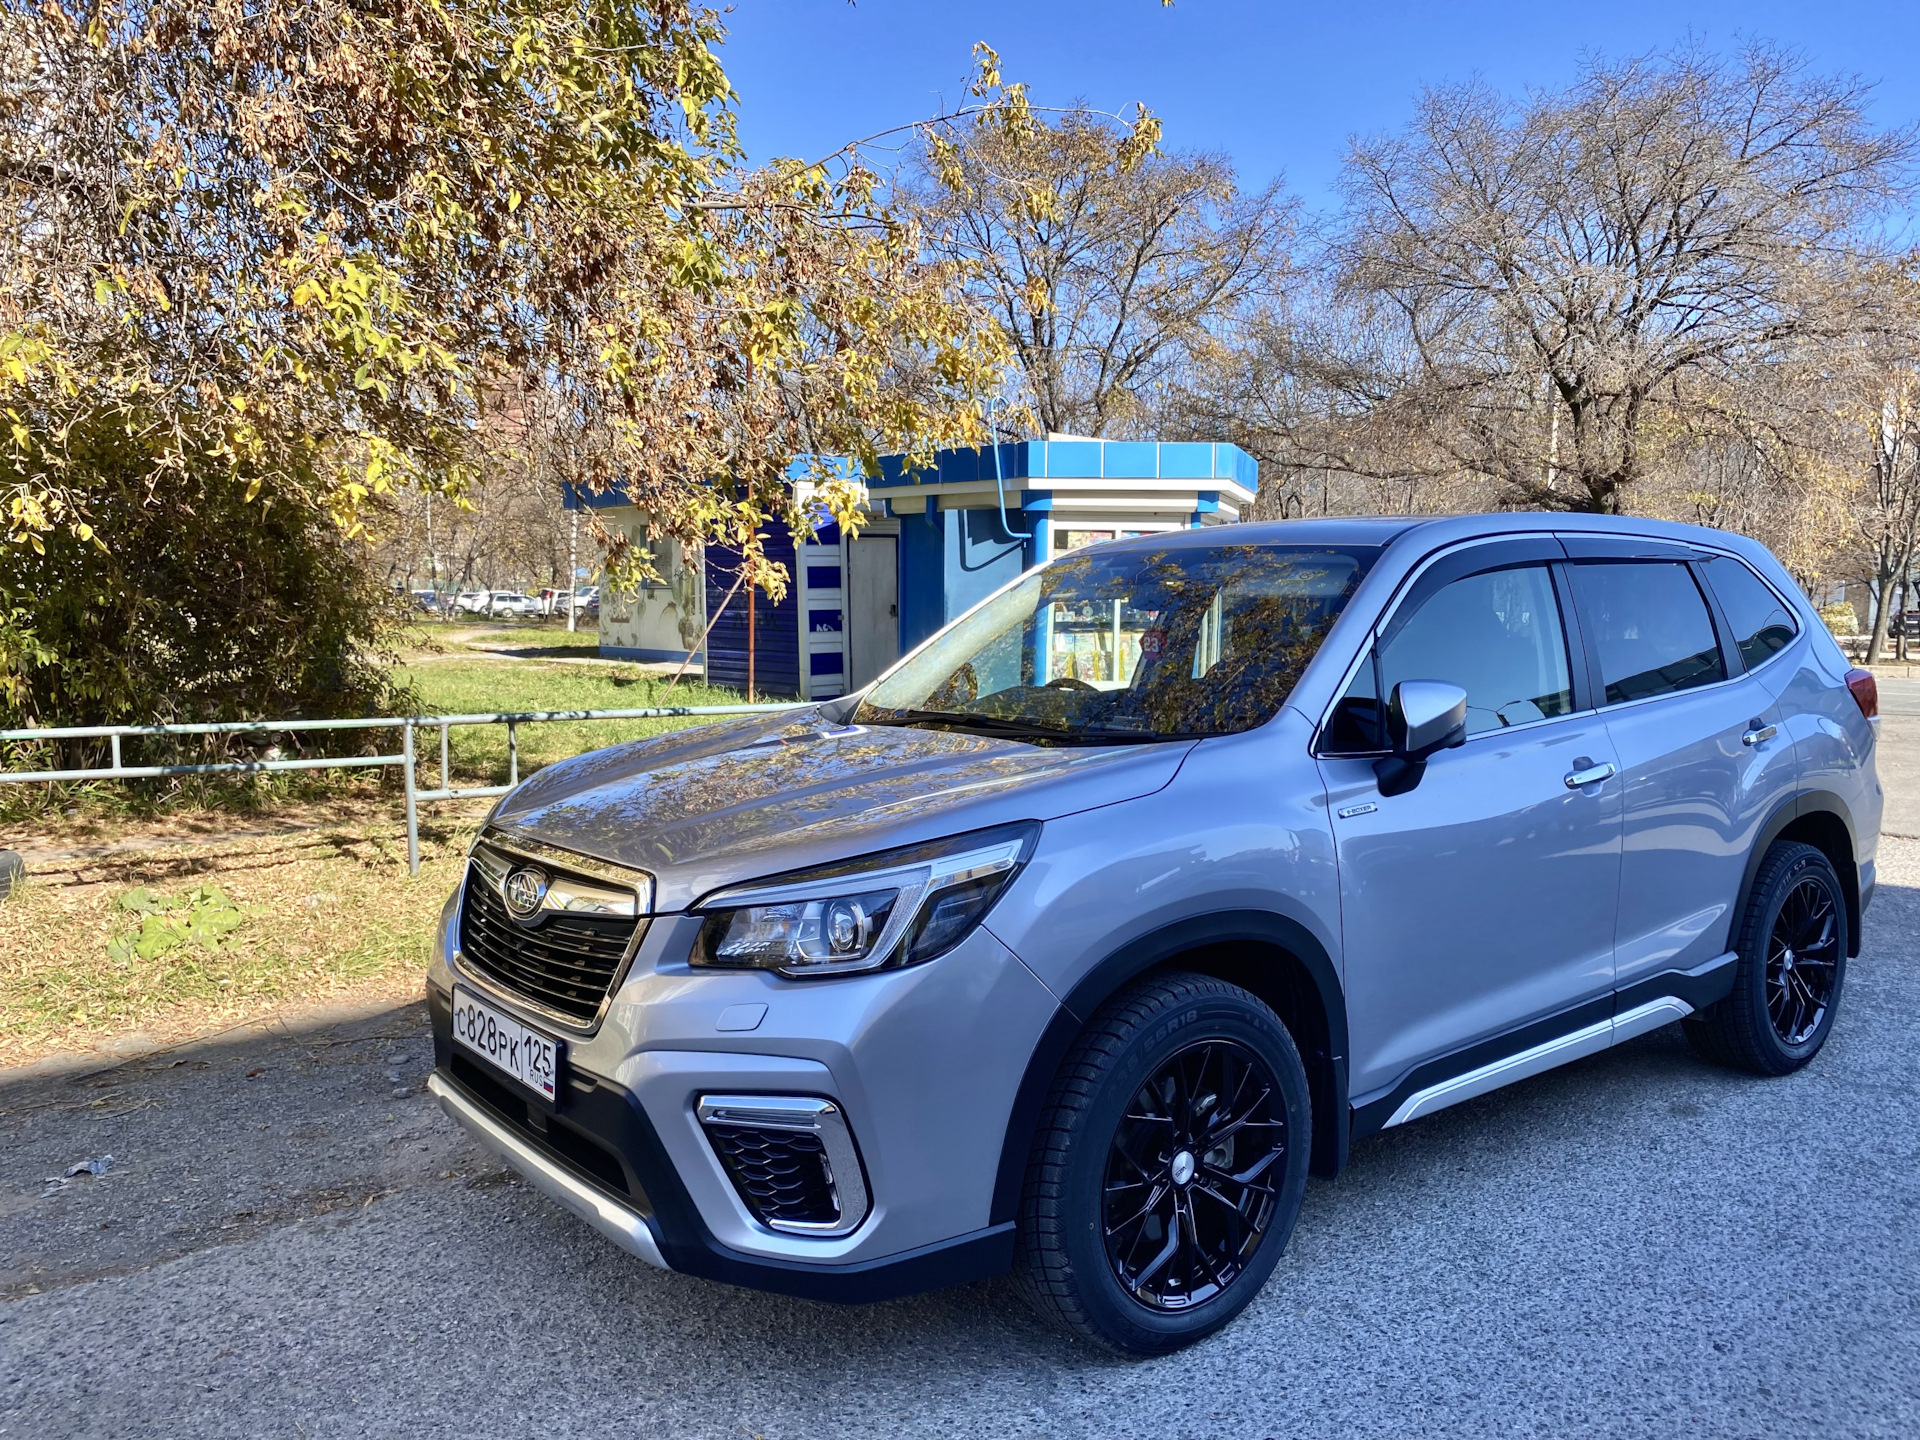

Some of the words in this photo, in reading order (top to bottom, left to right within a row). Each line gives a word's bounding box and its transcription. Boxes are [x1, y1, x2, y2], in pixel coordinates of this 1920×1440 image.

[1144, 636, 1159, 652] 23
[524, 1035, 551, 1077] 125
[530, 1069, 543, 1086] RUS
